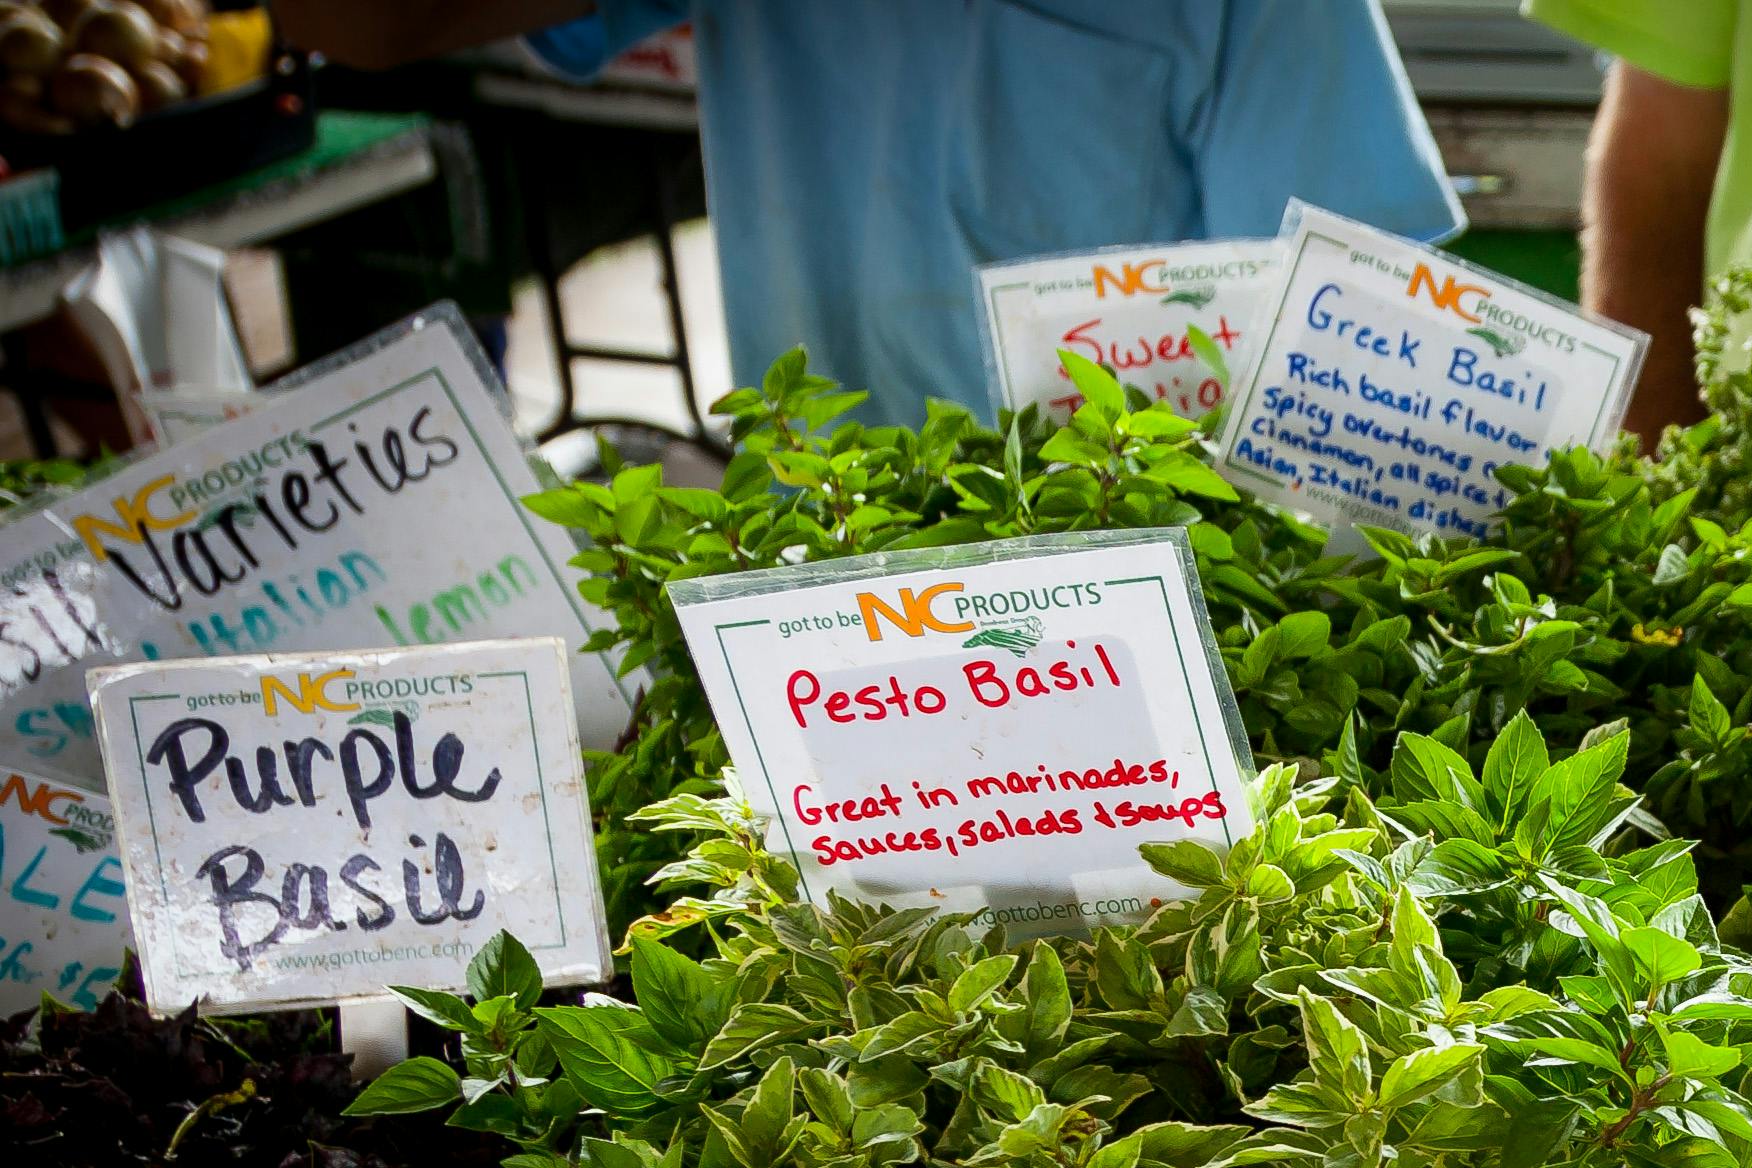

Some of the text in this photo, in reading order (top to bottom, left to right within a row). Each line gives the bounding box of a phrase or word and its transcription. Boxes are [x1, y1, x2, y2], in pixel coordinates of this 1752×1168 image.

[1091, 258, 1170, 299] NC
[1158, 260, 1258, 284] PRODUCTS
[1405, 262, 1493, 325] NC
[1474, 297, 1578, 355] PRODUCTS
[1306, 281, 1547, 412] Greek Basil
[1287, 350, 1538, 453] Rich basil flavor
[1342, 412, 1474, 473] overtones
[71, 472, 198, 562] NC
[168, 430, 313, 511] PRODUCTS
[104, 404, 459, 611] Varieties
[1307, 462, 1401, 512] Italian
[778, 616, 812, 639] got
[813, 615, 834, 631] to
[835, 609, 862, 628] be
[856, 581, 976, 643] NC
[955, 582, 1102, 619] PRODUCTS
[186, 693, 216, 712] got
[218, 692, 236, 706] to
[260, 670, 362, 717] NC
[345, 675, 474, 701] PRODUCTS
[786, 639, 1123, 729] Pesto Basil
[0, 774, 86, 826] NC
[147, 710, 504, 834] Purple
[792, 757, 1180, 827] Great in marinades,
[195, 831, 487, 974] Basil
[274, 942, 475, 972] www.gottobenc.com
